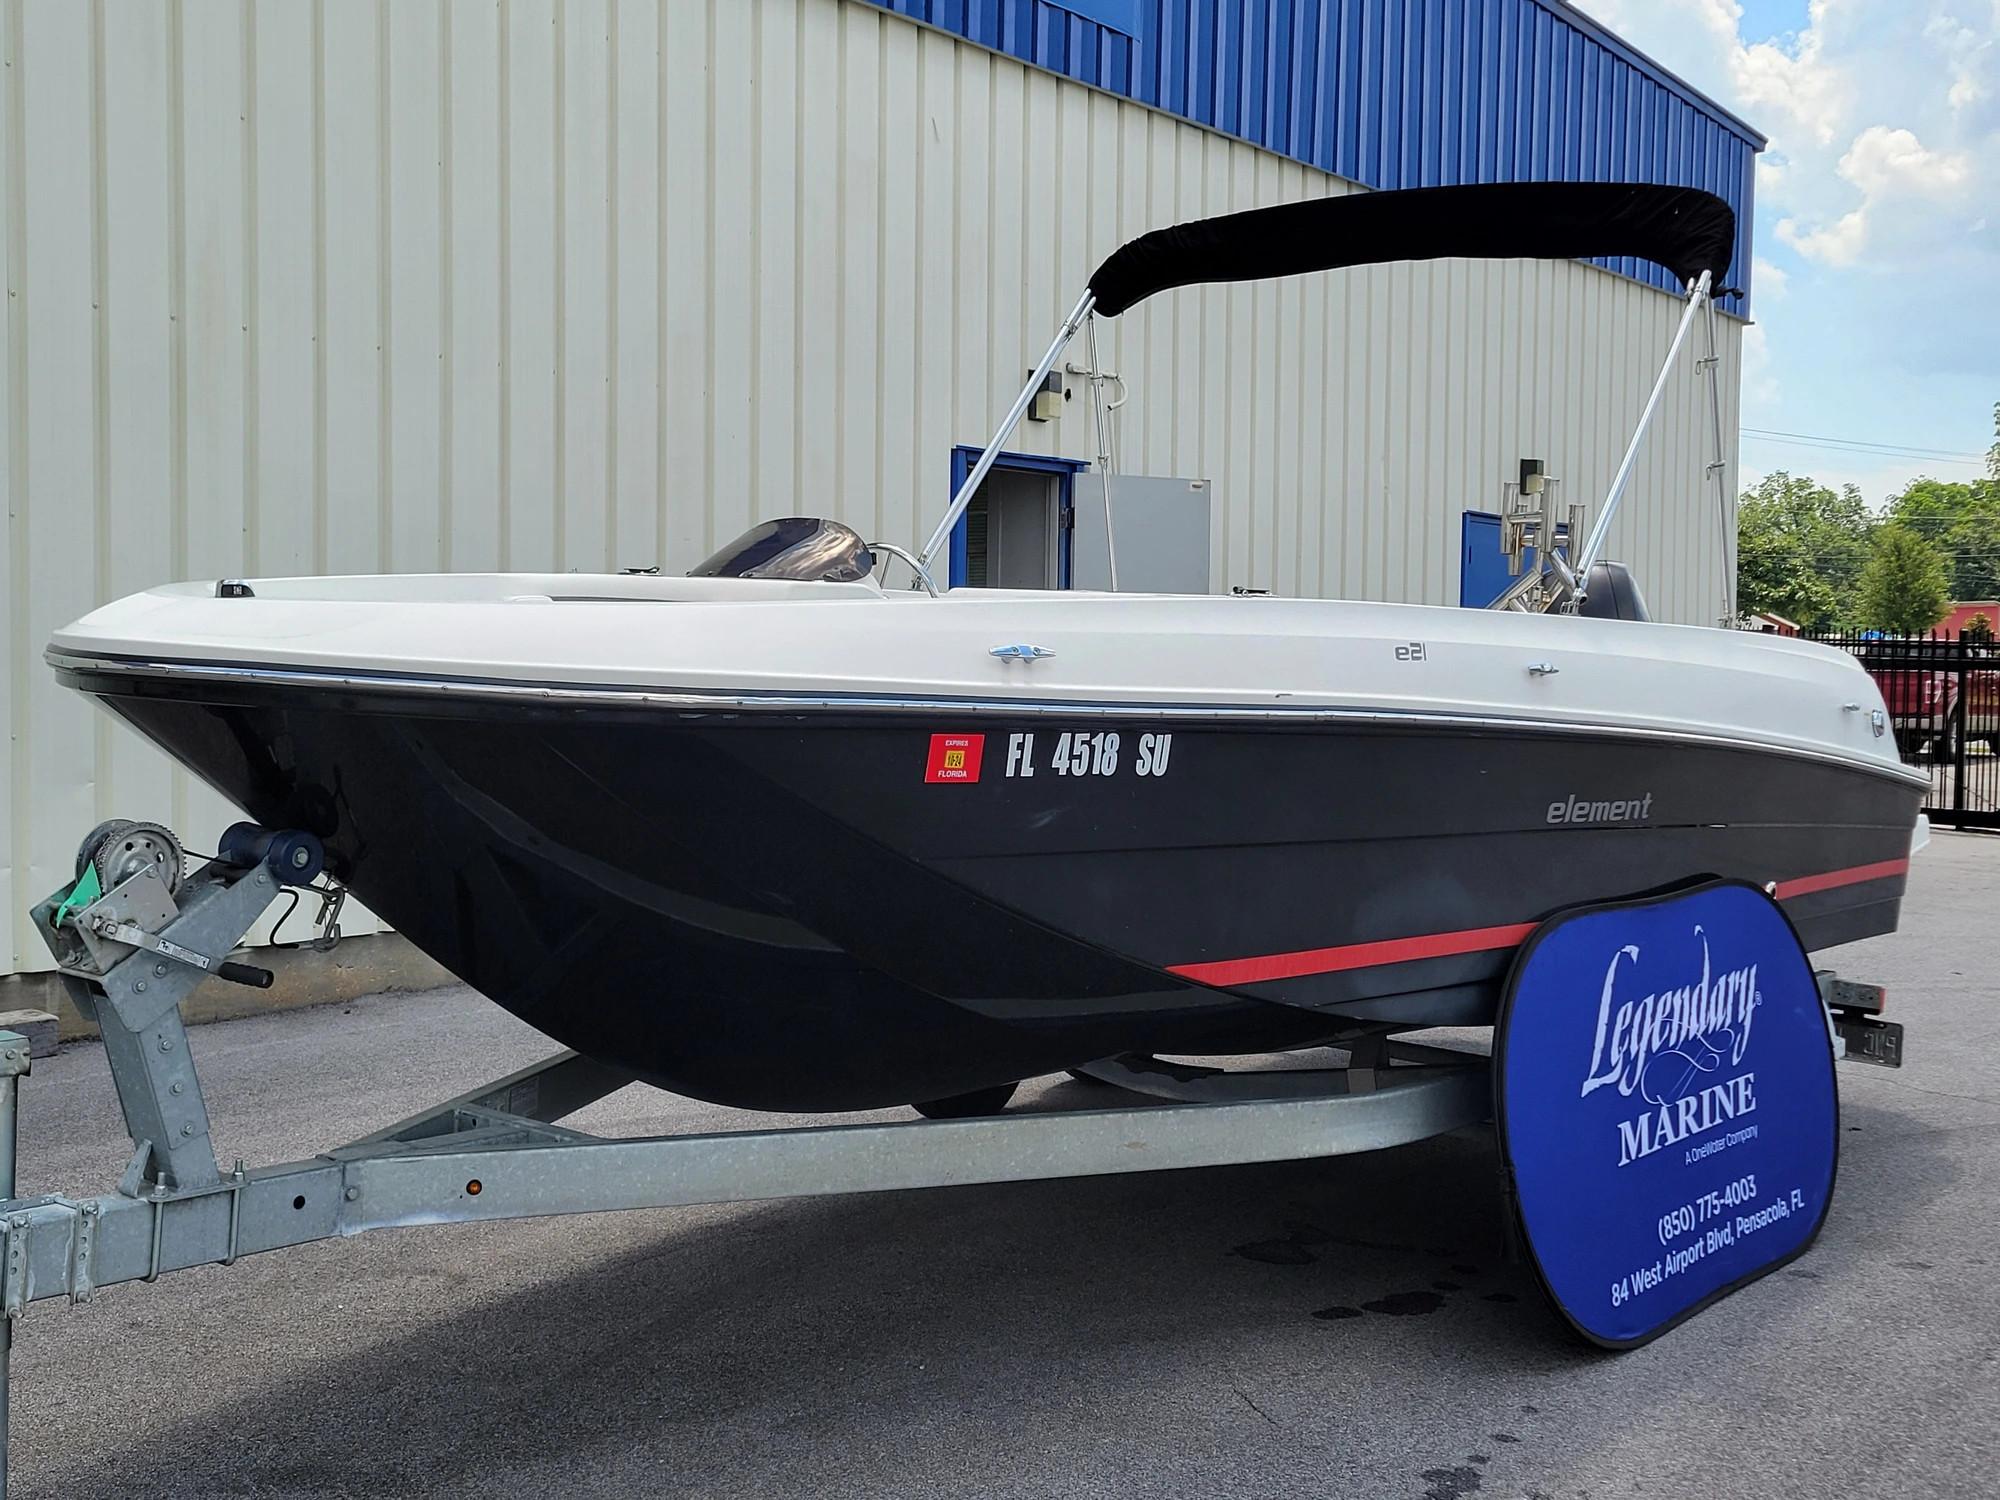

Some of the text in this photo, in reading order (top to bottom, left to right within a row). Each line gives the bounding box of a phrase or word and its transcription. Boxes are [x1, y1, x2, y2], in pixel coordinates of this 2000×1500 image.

[937, 770, 968, 778] FLORIDA
[1005, 732, 1172, 778] FL 4518 SU
[1546, 792, 1653, 824] element
[1581, 924, 1758, 1098] Legendary
[1617, 1072, 1757, 1167] MARINE
[1685, 1124, 1759, 1166] A OneWater Company
[1658, 1174, 1757, 1246] (850) 775-4003
[1611, 1188, 1805, 1307] 84 West Airport Blvd, Pensacola, FL
